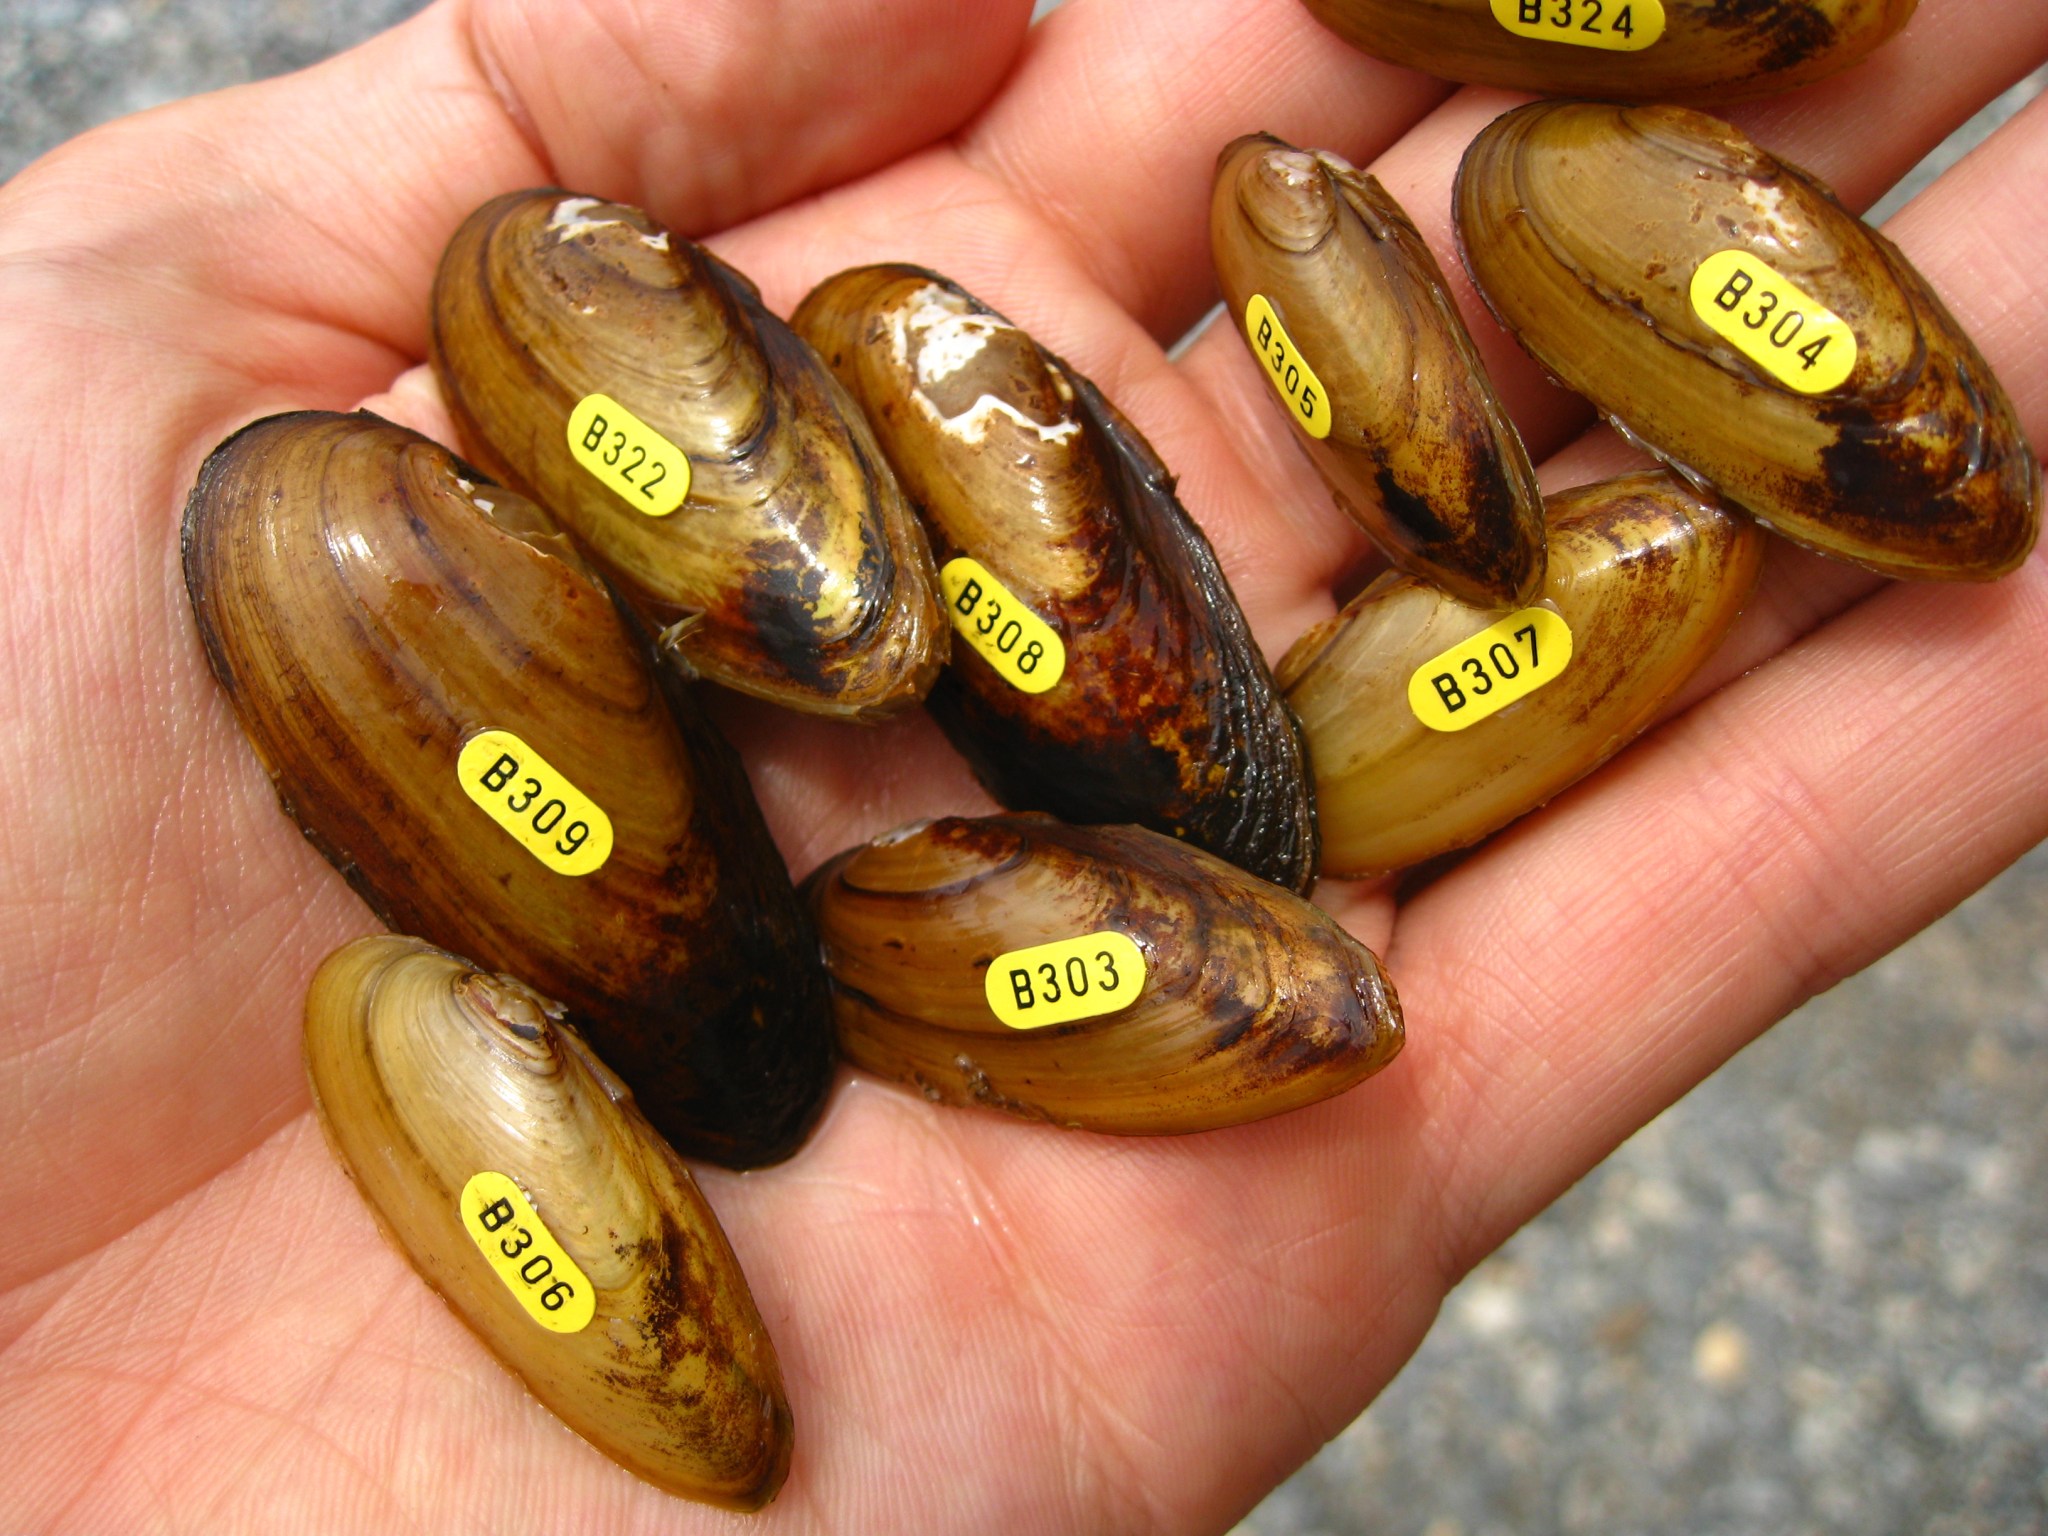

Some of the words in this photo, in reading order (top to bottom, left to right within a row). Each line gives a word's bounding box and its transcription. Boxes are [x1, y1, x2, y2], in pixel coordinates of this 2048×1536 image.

[1518, 0, 1634, 39] B324
[1257, 315, 1317, 419] B305
[1714, 269, 1831, 370] B304
[582, 413, 667, 501] B322
[955, 578, 1044, 675] B308
[1431, 623, 1539, 714] B307
[479, 753, 589, 856] B309
[1009, 951, 1119, 1010] B303
[478, 1197, 575, 1311] B306
